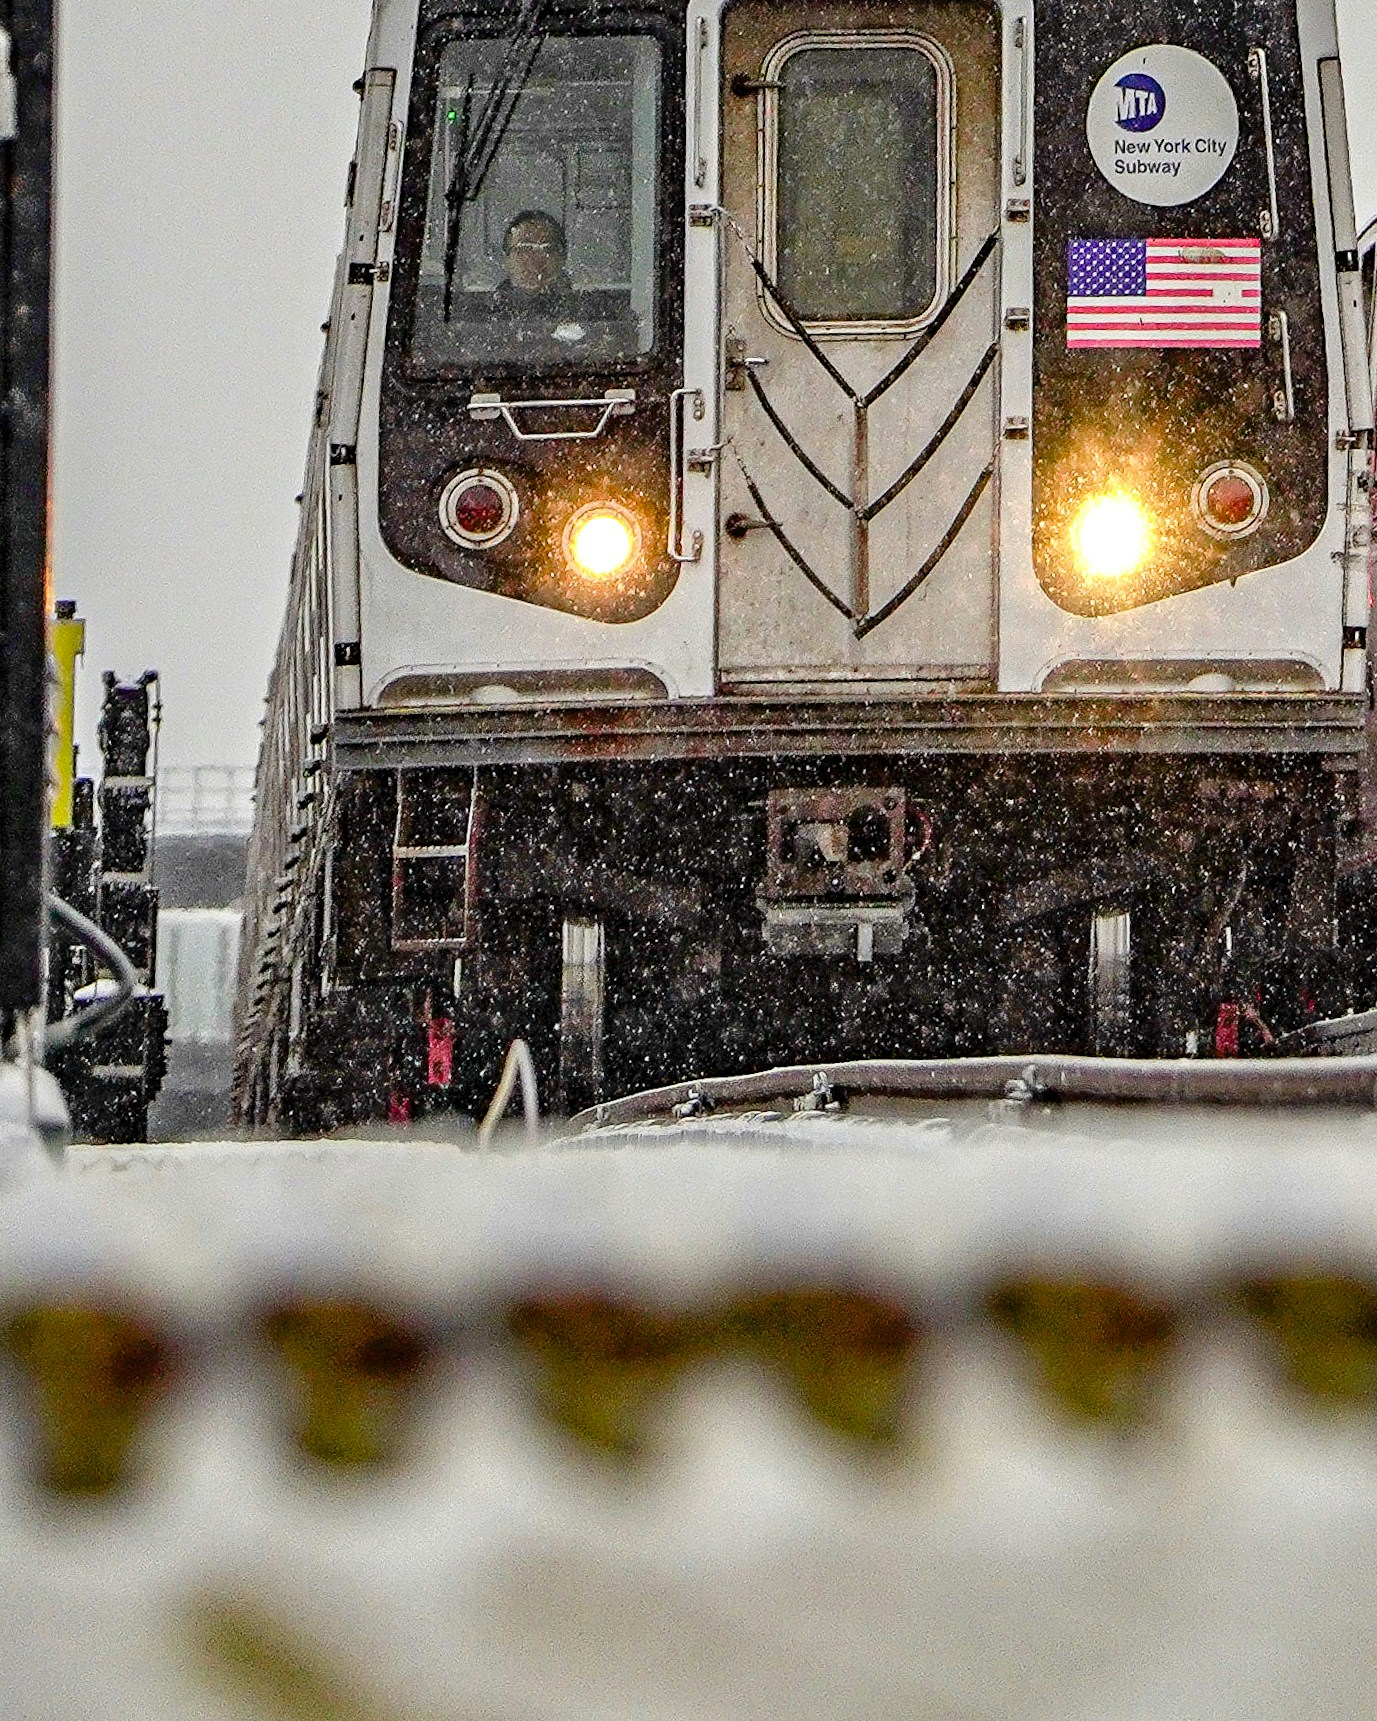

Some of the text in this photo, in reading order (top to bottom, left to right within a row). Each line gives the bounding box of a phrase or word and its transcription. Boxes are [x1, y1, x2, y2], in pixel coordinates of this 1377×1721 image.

[1113, 85, 1159, 123] MTA
[1114, 138, 1227, 157] New York City
[1114, 159, 1181, 177] Subway
